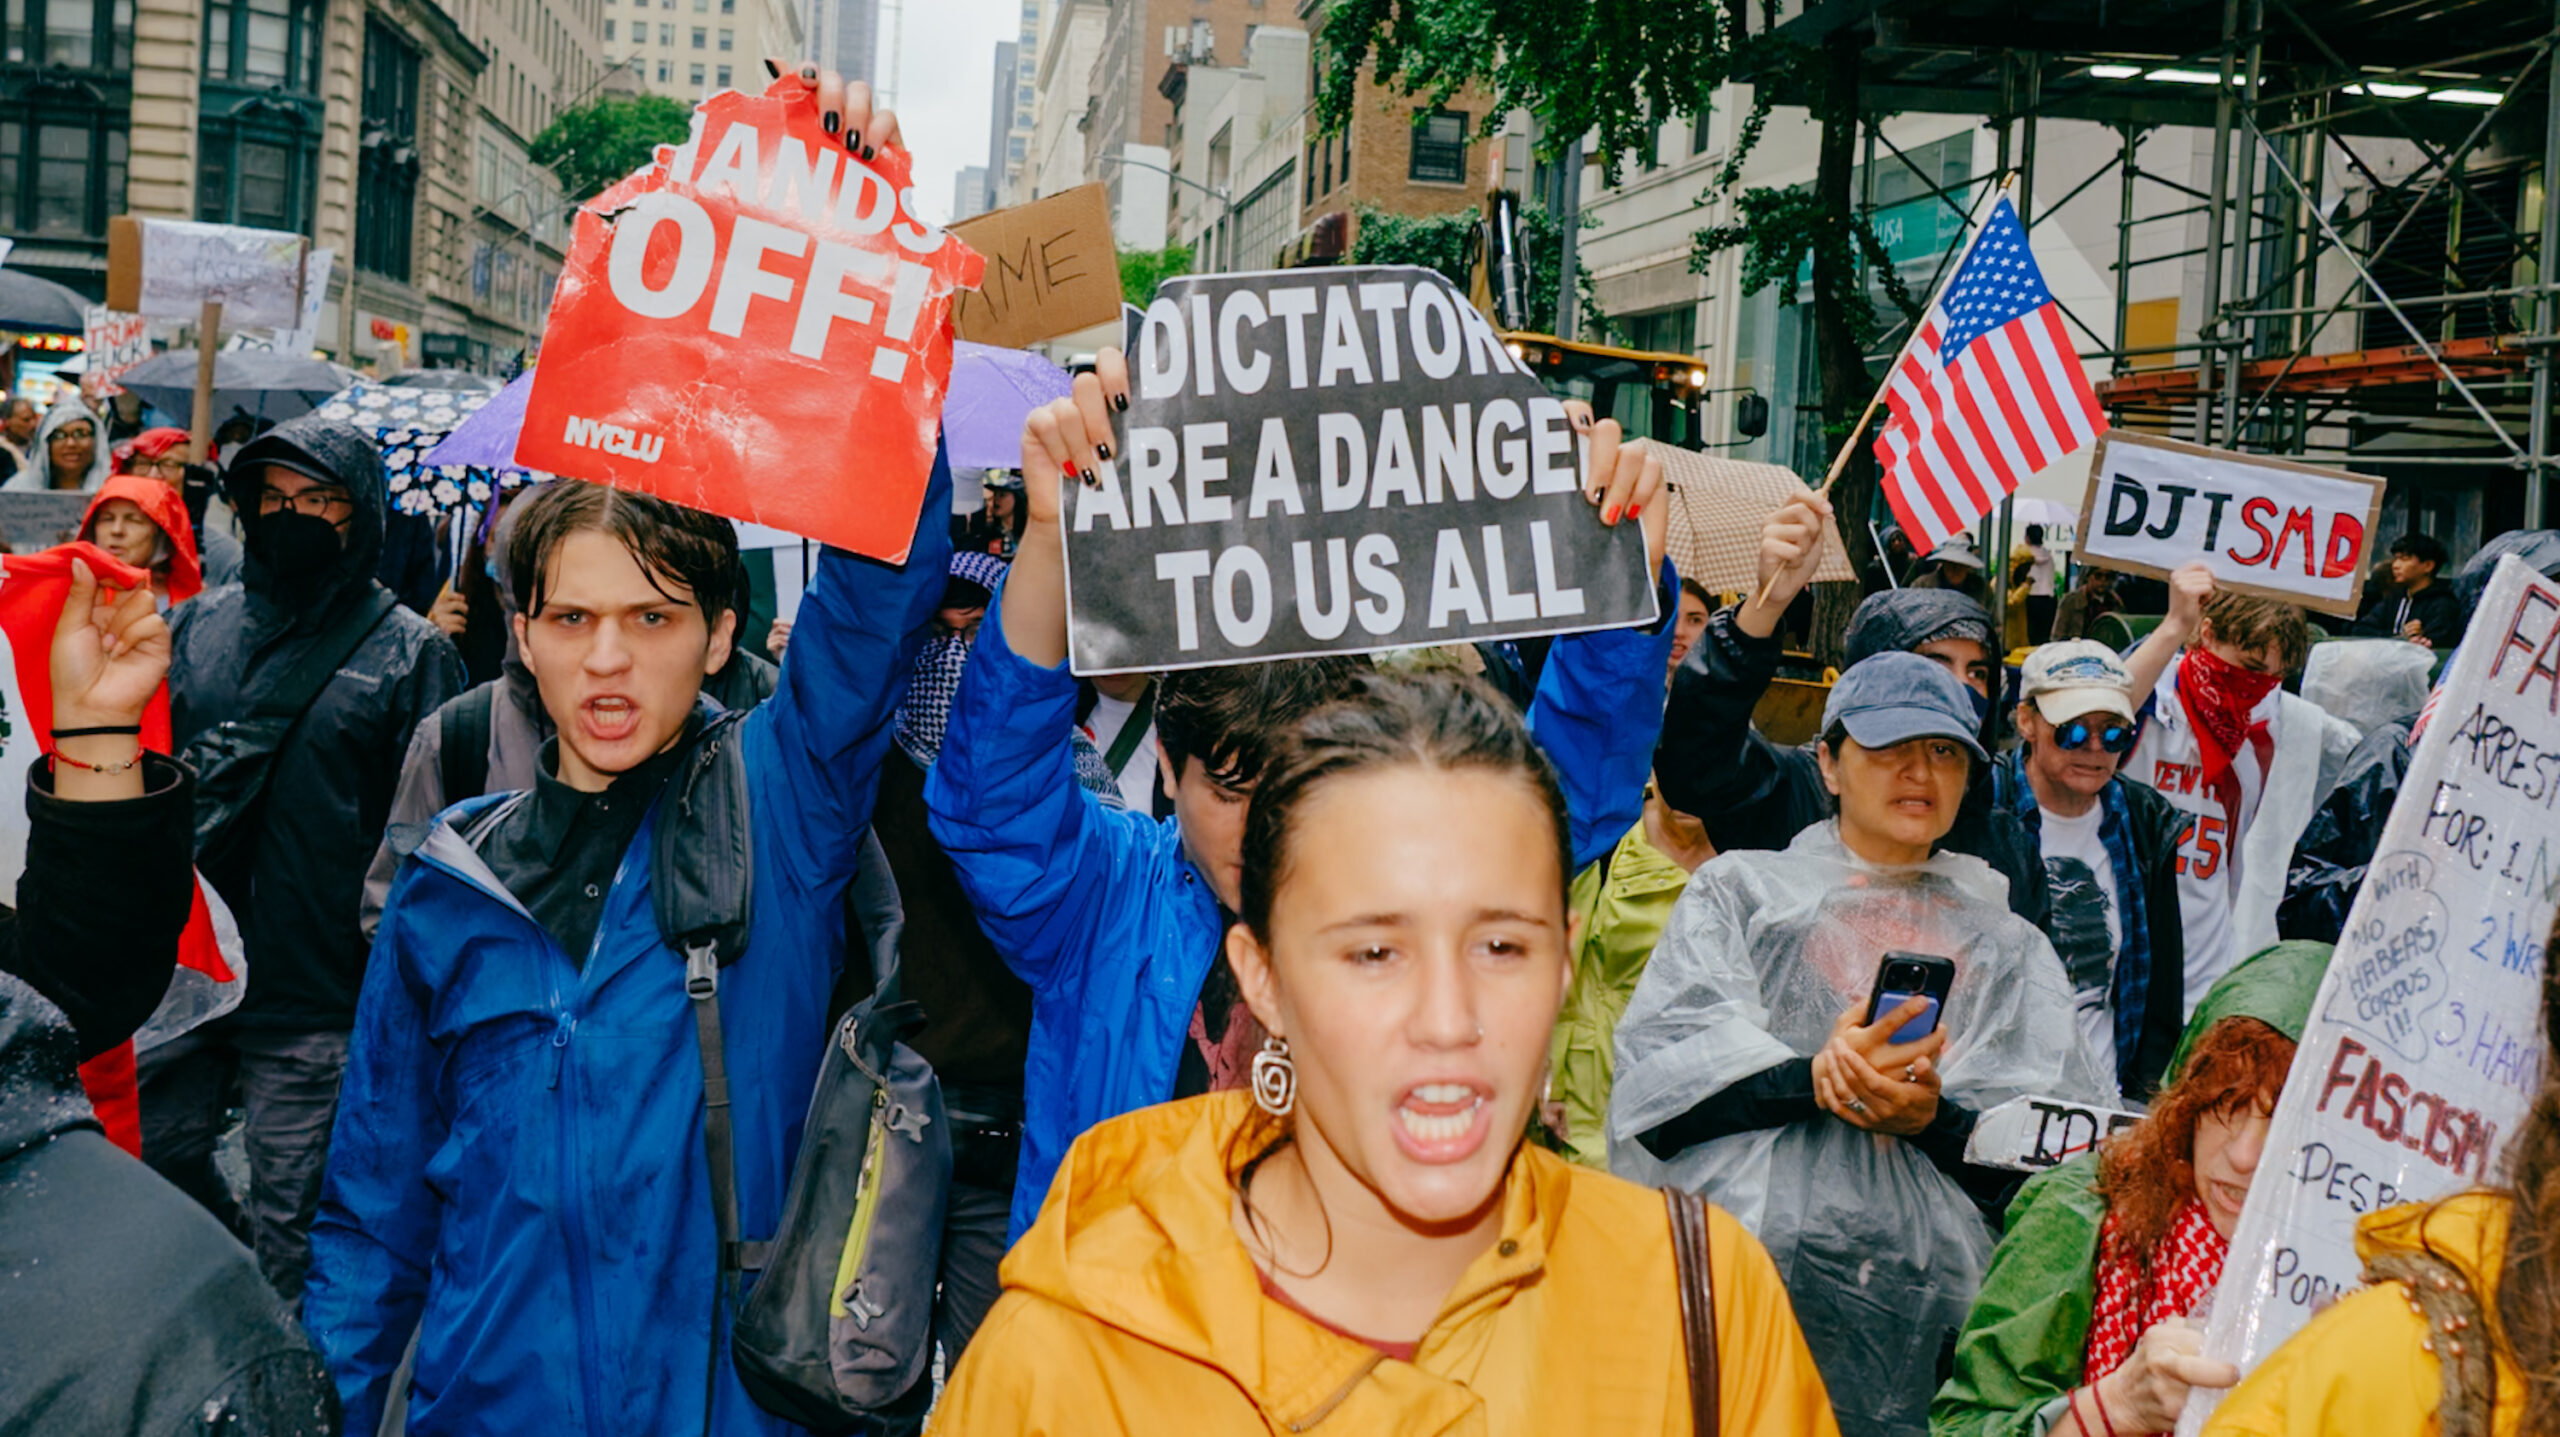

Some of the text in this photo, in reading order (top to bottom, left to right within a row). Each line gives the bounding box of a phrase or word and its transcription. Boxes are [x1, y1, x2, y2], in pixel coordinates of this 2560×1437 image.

[607, 191, 933, 384] OFF!
[1139, 280, 1538, 400] DICTATOR
[564, 415, 664, 463] NYCLU
[1073, 397, 1591, 533] ARE A DANGE
[2103, 472, 2364, 578] DJT SMD
[1155, 520, 1585, 652] TO US ALL
[2372, 857, 2421, 902] WITH
[2422, 780, 2493, 870] FOR:
[2348, 914, 2437, 1001] HABEAS
[2316, 1036, 2498, 1184] FASCISM
